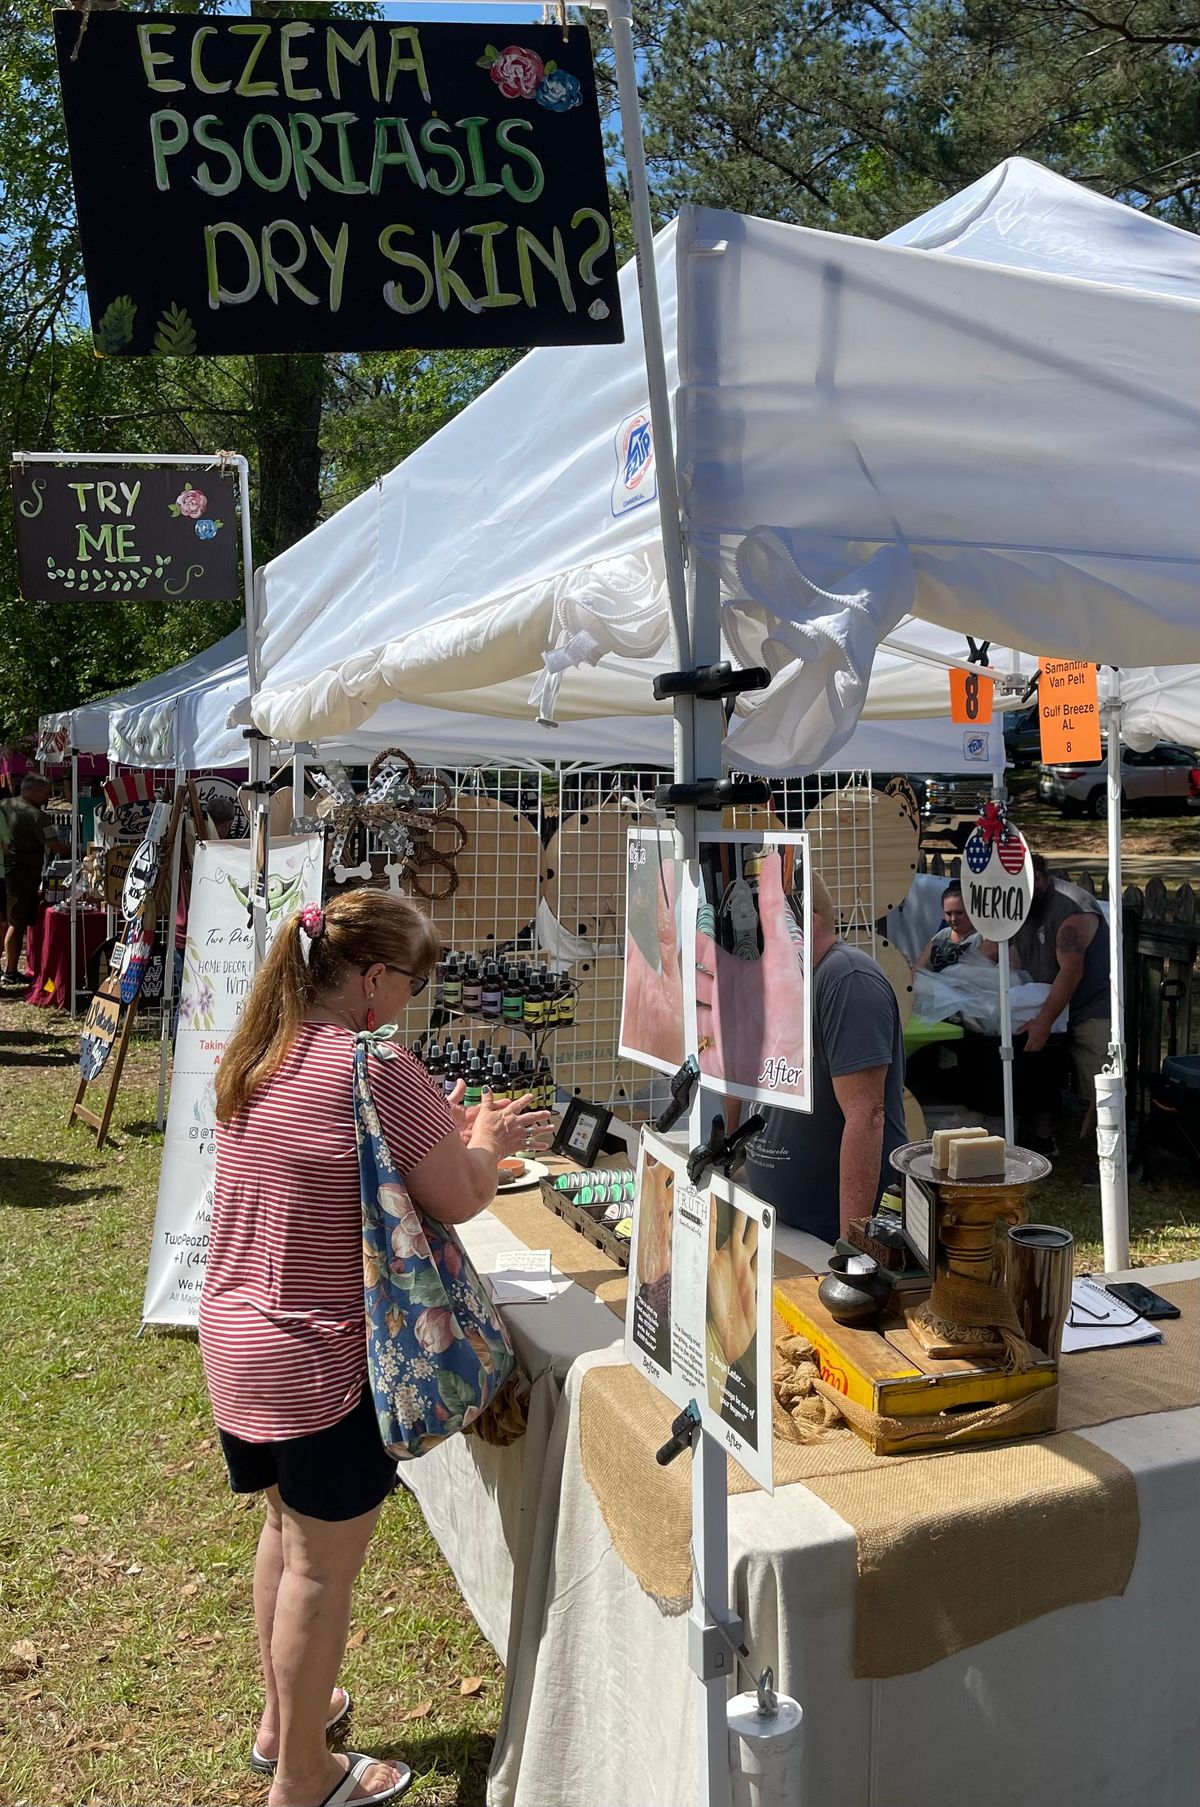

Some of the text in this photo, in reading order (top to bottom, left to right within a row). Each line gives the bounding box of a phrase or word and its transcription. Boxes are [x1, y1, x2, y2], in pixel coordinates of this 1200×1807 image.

[137, 21, 432, 105] ECZEMA
[149, 107, 546, 203] PSORIASIS
[203, 218, 349, 313] DRY
[377, 207, 612, 321] SKIN?
[67, 480, 142, 517] TRY
[77, 523, 142, 564] ME
[1049, 674, 1085, 688] Van Pelt
[965, 673, 979, 720] 8
[1043, 703, 1095, 718] Gulf Breeze
[1062, 718, 1075, 731] AL
[1066, 741, 1072, 753] 8
[205, 928, 225, 947] Two
[198, 959, 247, 976] HOME DECOR
[758, 1057, 803, 1089] After
[676, 1189, 708, 1220] TRUTH
[178, 1279, 194, 1290] We
[642, 1355, 660, 1379] Before
[725, 1430, 742, 1452] After
